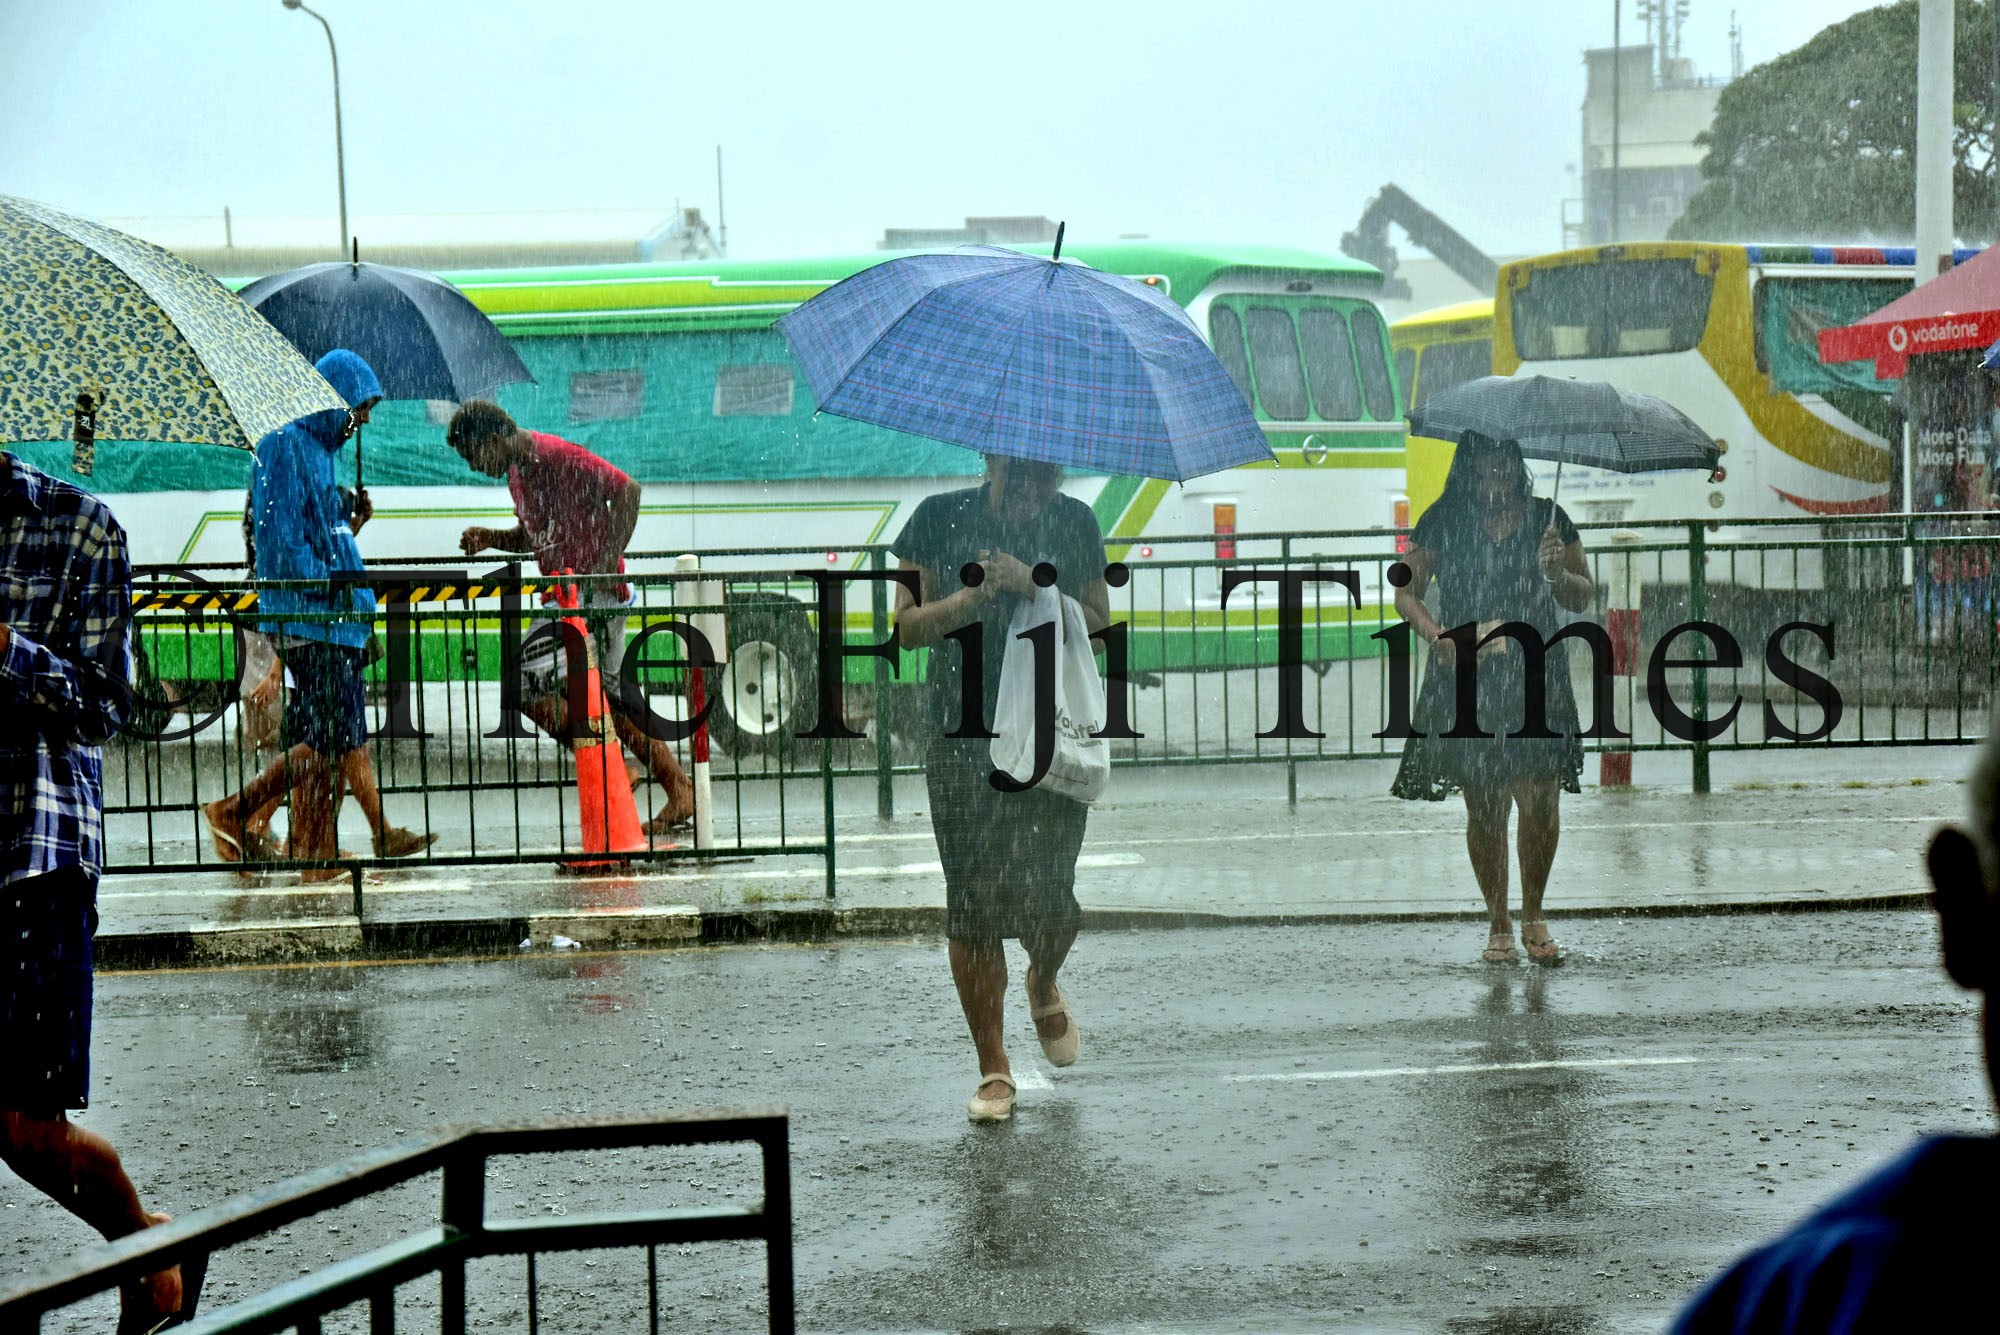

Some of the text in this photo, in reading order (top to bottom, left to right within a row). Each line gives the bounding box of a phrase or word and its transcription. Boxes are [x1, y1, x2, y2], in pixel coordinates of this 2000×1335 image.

[1911, 322, 1978, 343] vodafone
[1919, 427, 1991, 445] More Data
[1918, 448, 1985, 465] More Fun
